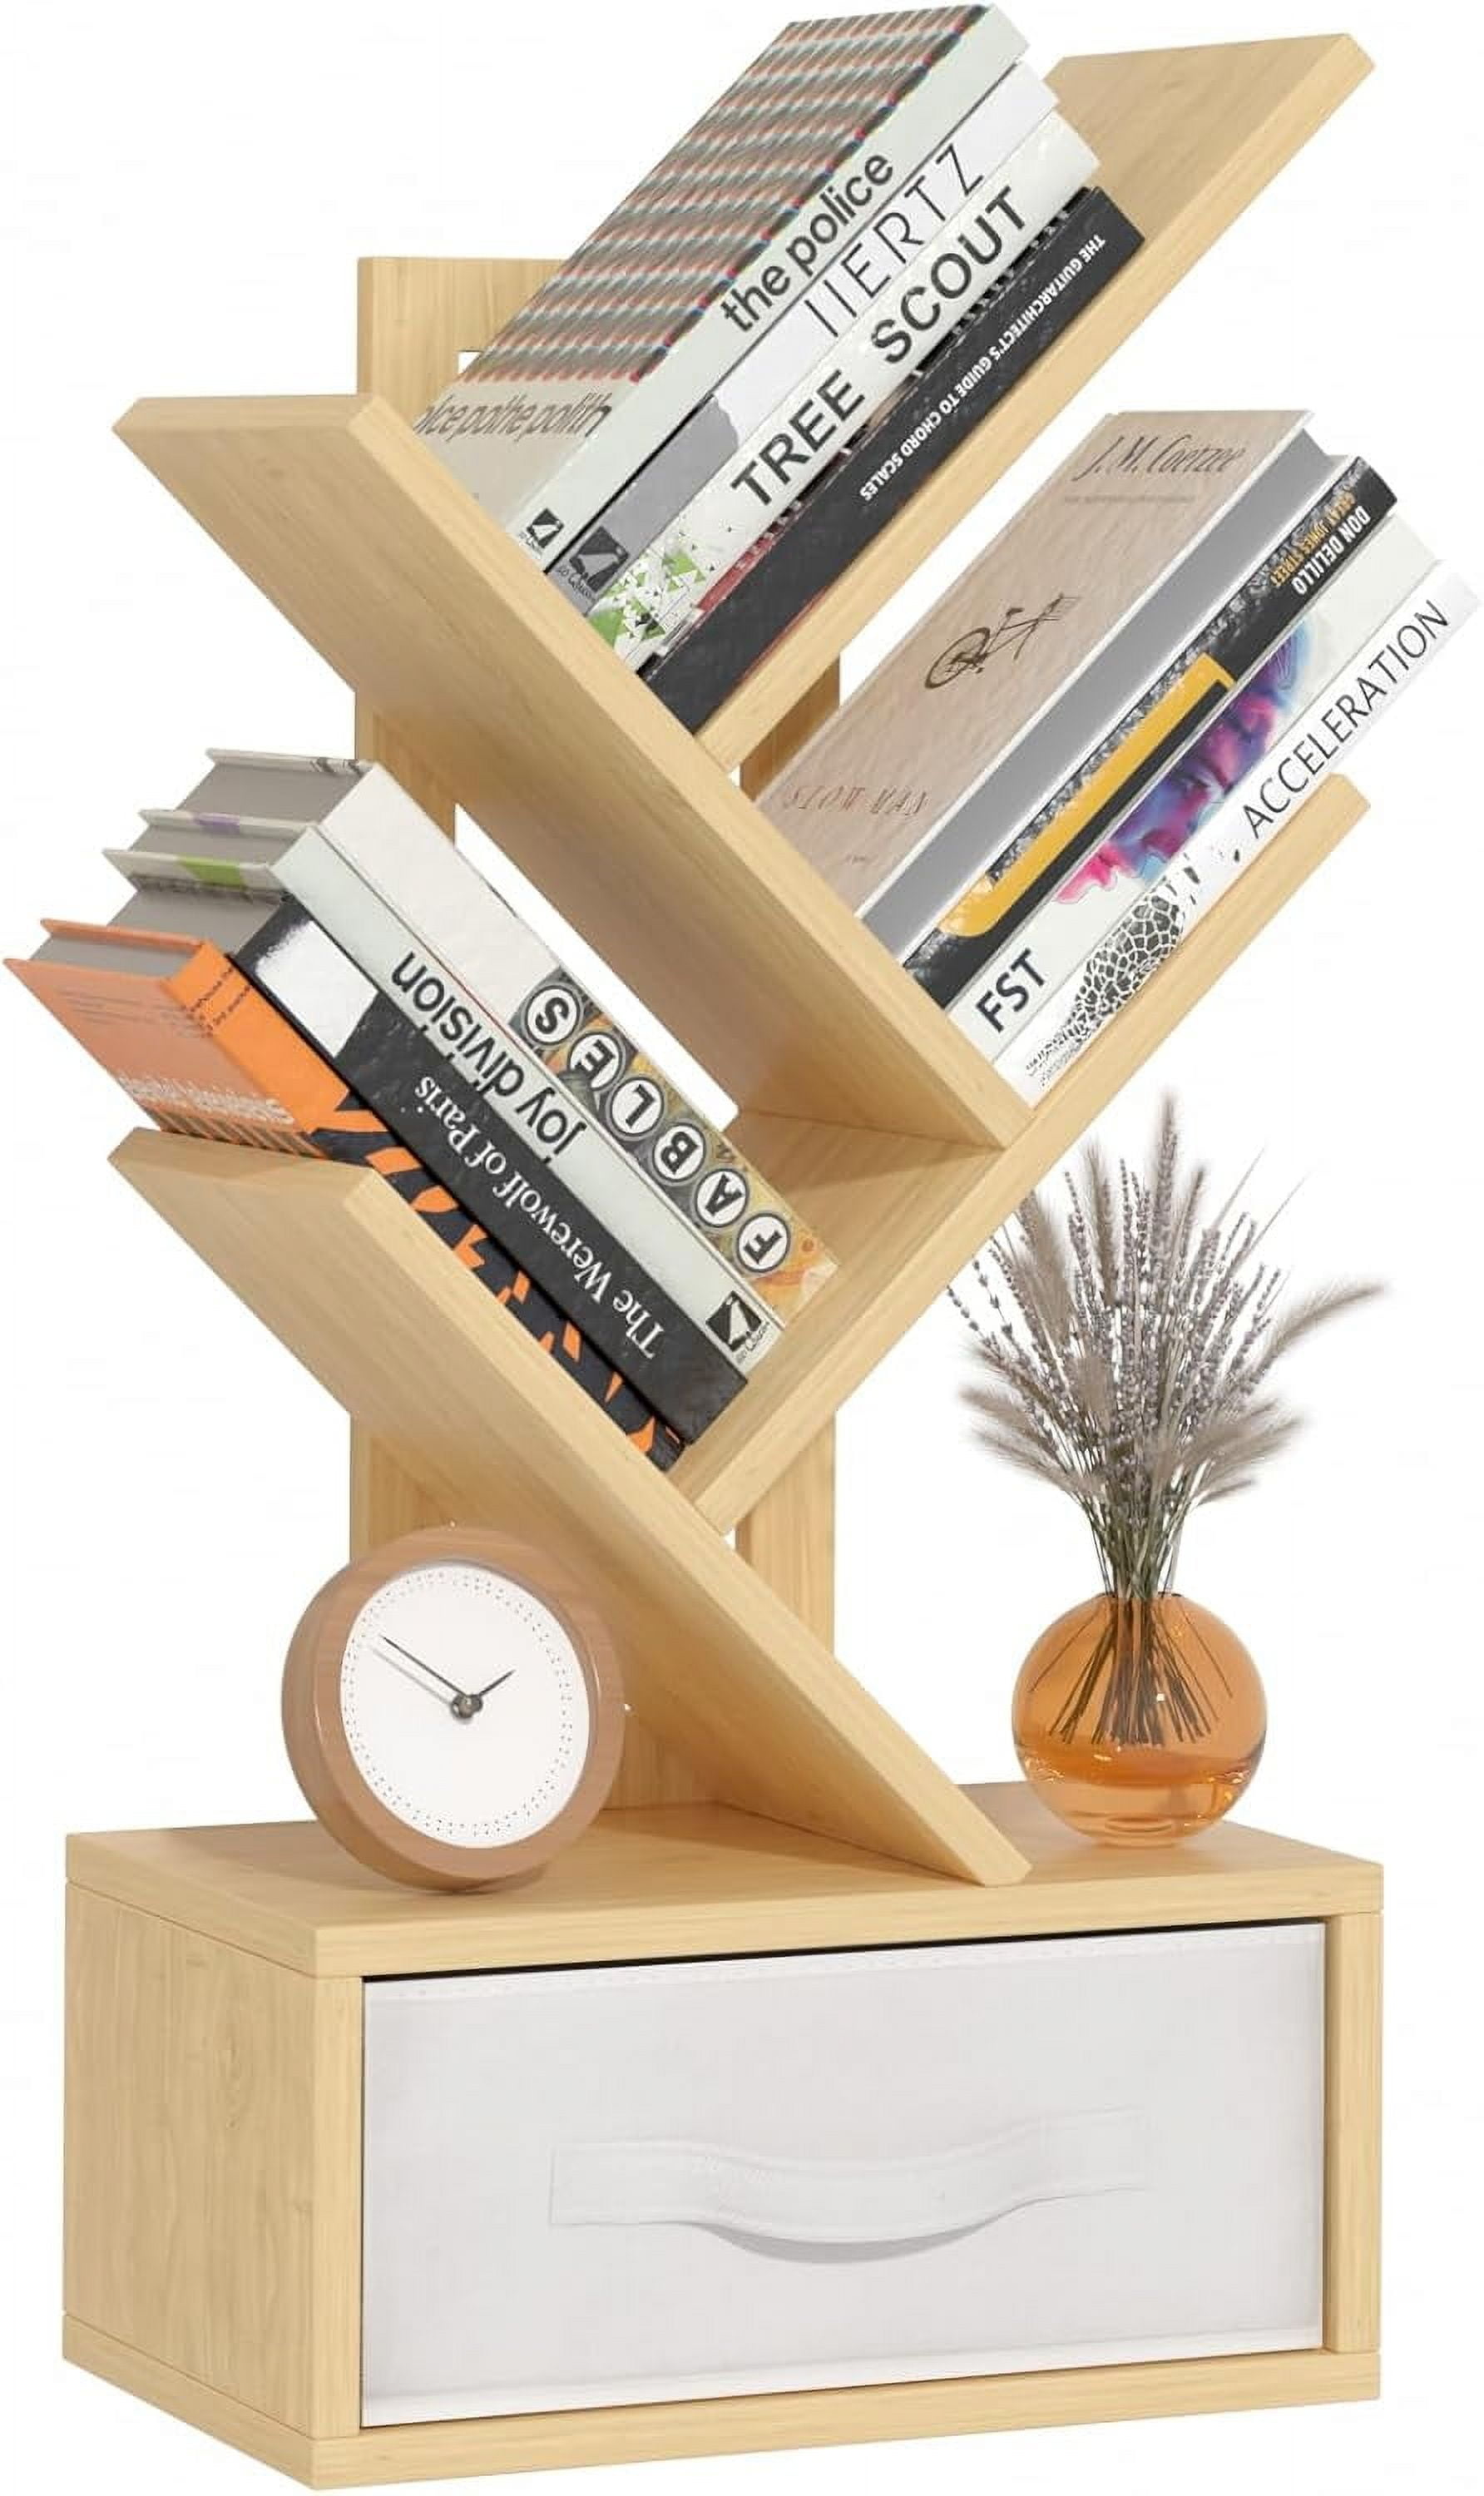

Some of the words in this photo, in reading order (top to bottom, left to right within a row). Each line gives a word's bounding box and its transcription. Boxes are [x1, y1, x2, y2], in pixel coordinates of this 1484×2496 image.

[720, 265, 790, 332] the
[785, 154, 893, 276] police
[1079, 234, 1106, 263] THE
[730, 369, 866, 506] TREE
[871, 186, 1026, 364] SCOUT
[988, 257, 1083, 361] GUITARCHITECT'S
[938, 393, 961, 414] TO
[953, 356, 992, 398] GUIDE
[900, 411, 942, 457] CHORD
[859, 452, 903, 501] SCALES
[1337, 504, 1371, 543] DON
[1291, 534, 1345, 595] DELILLO
[1244, 599, 1449, 839] ACCELERATION
[391, 951, 525, 1096] division
[975, 948, 1046, 1033] FST
[414, 1077, 482, 1155] Paris
[514, 1086, 587, 1166] joy
[535, 997, 783, 1265] FABLES
[463, 1141, 507, 1175] of
[492, 1171, 612, 1305] Werewolf
[612, 1290, 664, 1359] The
